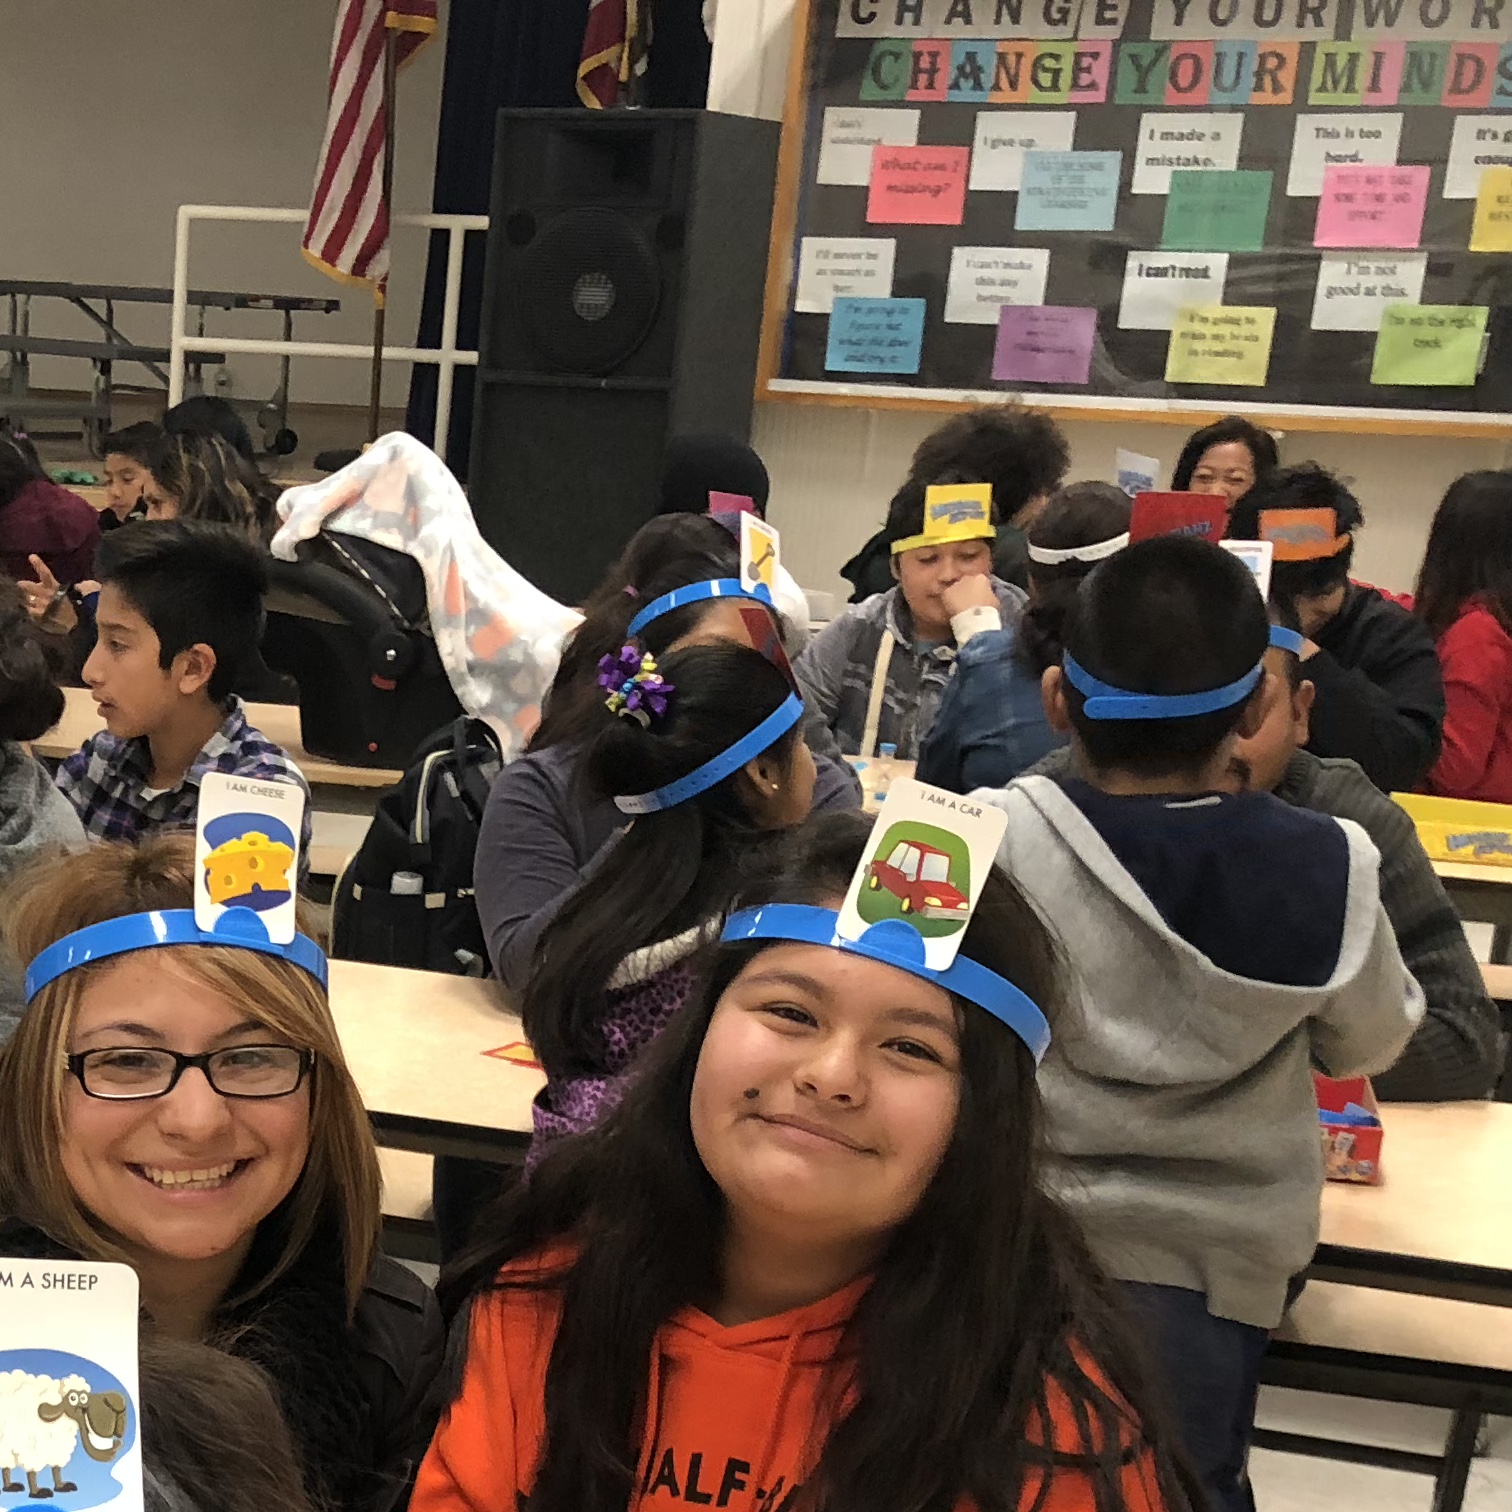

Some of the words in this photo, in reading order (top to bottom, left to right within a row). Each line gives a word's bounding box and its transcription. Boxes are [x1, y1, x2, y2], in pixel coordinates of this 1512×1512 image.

[850, 0, 1118, 26] CHANGE
[1171, 0, 1326, 28] YOUR
[871, 50, 1100, 93] CHANGE
[1127, 50, 1287, 96] YOUR
[1148, 128, 1155, 141] I
[1159, 128, 1206, 142] made
[1210, 131, 1222, 141] a
[1314, 127, 1340, 139] This
[1345, 127, 1355, 139] is
[1359, 127, 1382, 139] too
[231, 784, 248, 794] AM
[250, 786, 286, 800] CHEESE
[928, 794, 945, 806] AM
[948, 801, 956, 810] A
[960, 804, 983, 818] CAR
[20, 1272, 35, 1289] A
[41, 1272, 99, 1290] SHEEP
